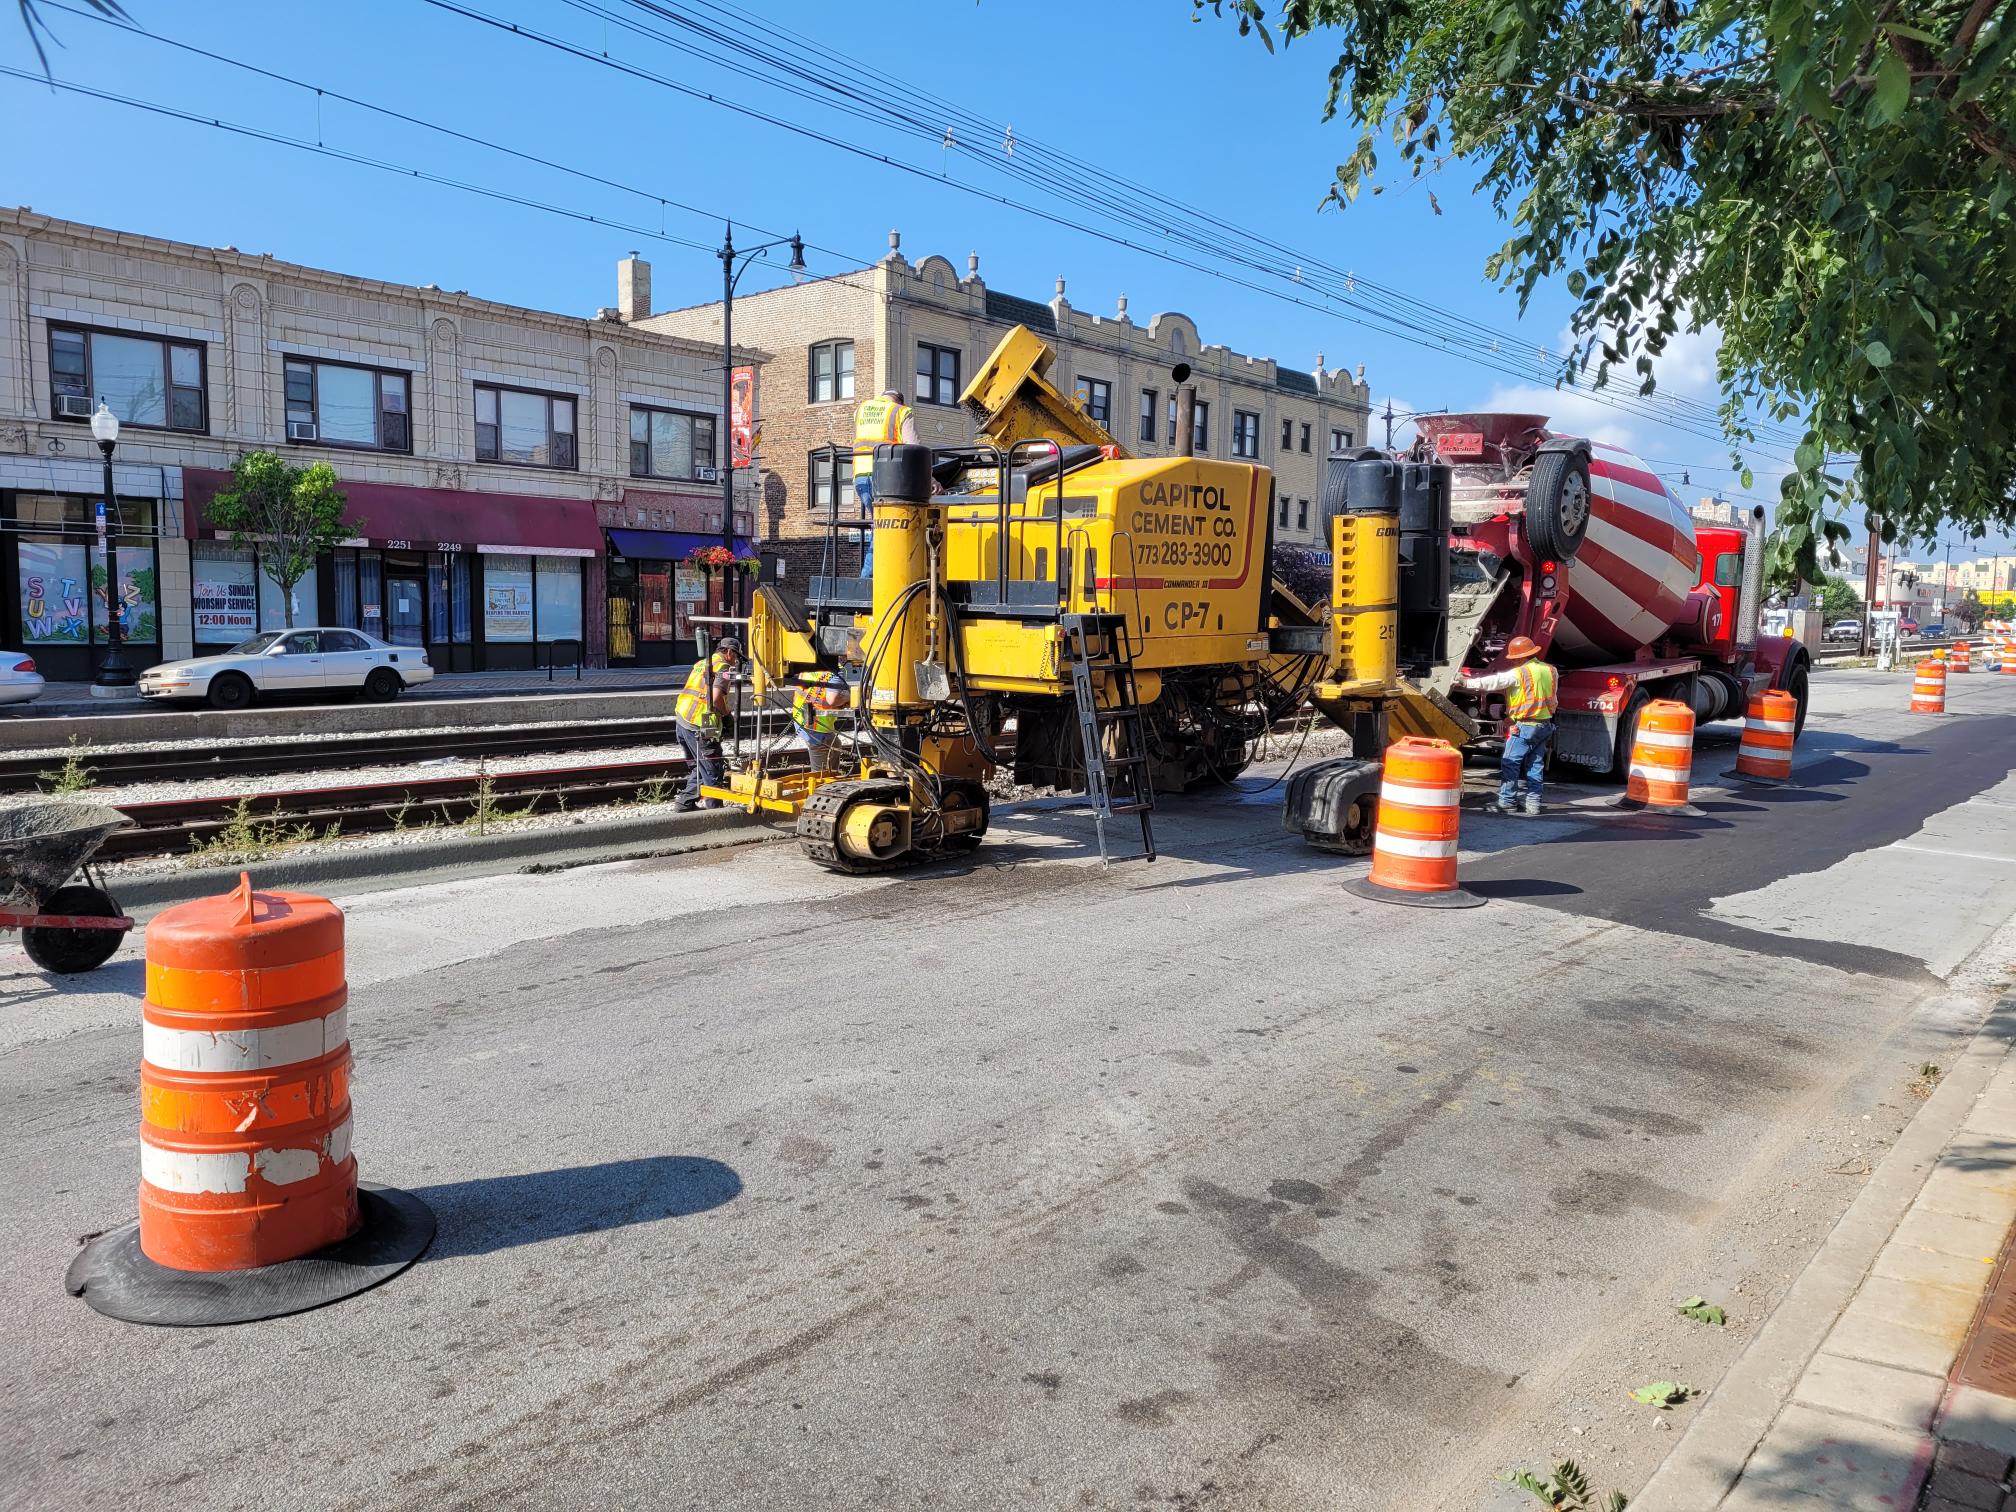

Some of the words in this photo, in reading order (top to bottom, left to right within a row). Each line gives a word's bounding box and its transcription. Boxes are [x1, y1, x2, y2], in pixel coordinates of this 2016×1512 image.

[1140, 480, 1231, 511] CAPITOL
[874, 518, 911, 530] MACO
[1131, 510, 1207, 537] CEMENT
[1213, 516, 1237, 538] CO.
[387, 539, 412, 550] 2251
[437, 542, 462, 552] 2249
[1161, 540, 1232, 567] 283-3900
[228, 584, 255, 597] SUNDAY
[1164, 580, 1200, 589] COMMANDER
[193, 597, 227, 610] WORSHIP
[227, 598, 256, 610] SERVICE
[199, 614, 226, 625] 12:00
[227, 614, 252, 625] Noon
[1164, 601, 1211, 631] CP-7
[1379, 624, 1395, 640] 25
[1587, 700, 1614, 711] 1704
